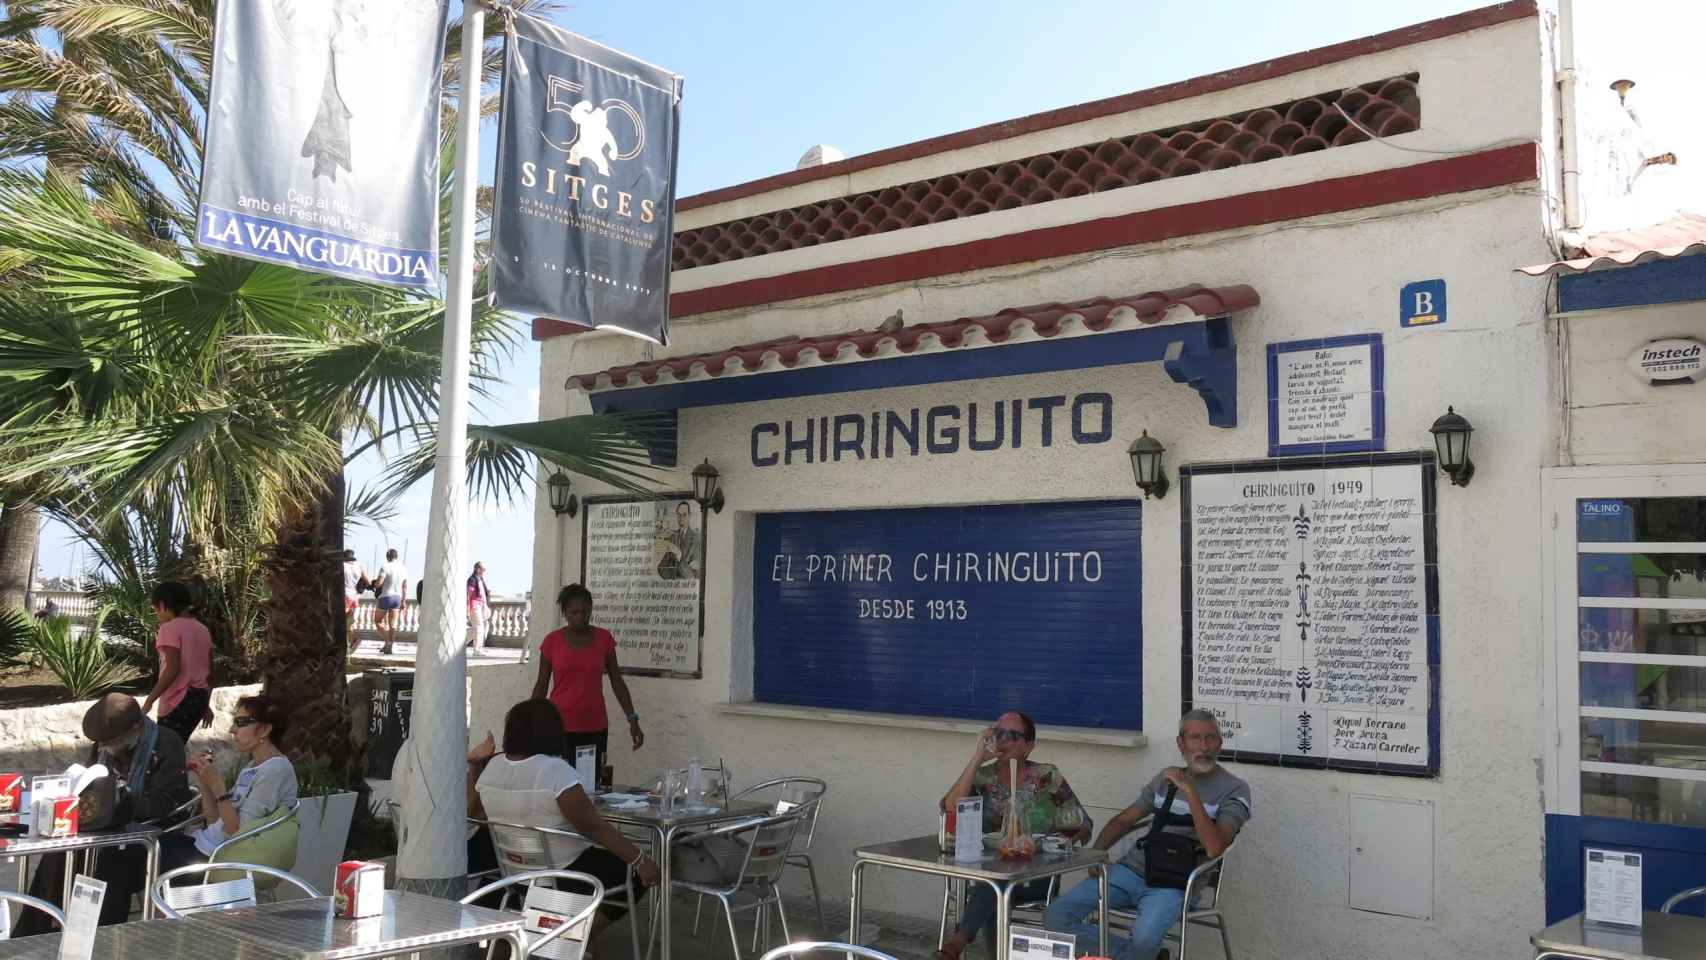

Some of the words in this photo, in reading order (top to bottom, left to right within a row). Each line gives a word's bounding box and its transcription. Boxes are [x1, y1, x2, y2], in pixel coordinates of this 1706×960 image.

[288, 188, 313, 208] Cap
[316, 197, 329, 209] al
[521, 161, 655, 223] SITGES
[238, 196, 270, 212] amb
[273, 202, 286, 216] el
[289, 205, 341, 228] Festival
[343, 219, 360, 232] de
[519, 206, 551, 221] CINEMA
[534, 200, 573, 218] FESTIVAL
[579, 214, 640, 237] INTERNACIONAL
[206, 211, 244, 246] LA
[244, 222, 433, 280] VANGUARDIA
[1414, 291, 1433, 316] B
[1643, 345, 1700, 360] instech
[751, 392, 1113, 467] CHIRINGUITO
[1243, 482, 1315, 498] CHIRINGUITO
[1331, 480, 1363, 496] 1949
[772, 555, 794, 582] EL
[859, 599, 915, 620] DESDE
[927, 600, 968, 620] 1913
[373, 701, 389, 718] PAU
[370, 717, 382, 735] 39
[1366, 717, 1406, 729] Serrano
